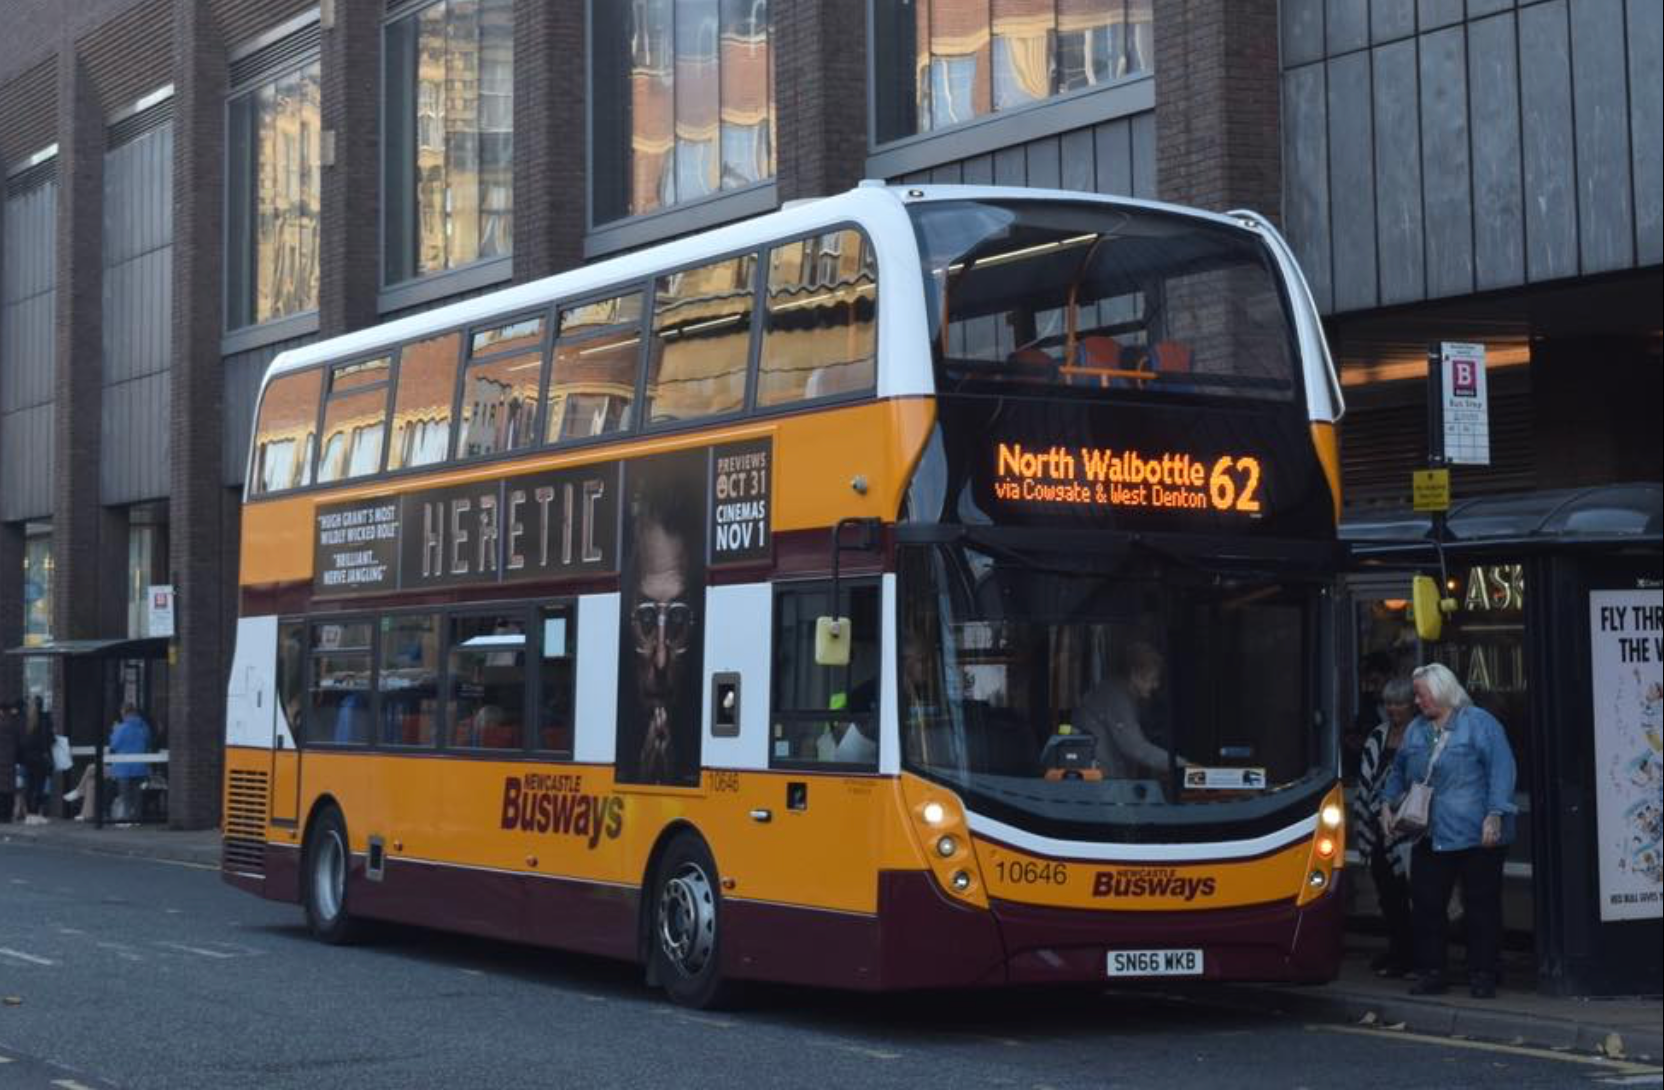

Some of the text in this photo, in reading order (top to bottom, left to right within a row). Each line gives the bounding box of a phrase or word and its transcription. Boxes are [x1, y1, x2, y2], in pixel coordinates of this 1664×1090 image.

[1456, 363, 1472, 386] B
[717, 452, 766, 474] PREVIEWS
[998, 443, 1206, 487] North Walbottle
[716, 470, 766, 499] OCT 31
[995, 478, 1207, 509] via Cowgate & West Denton
[1208, 455, 1261, 512] 62
[716, 500, 766, 523] CINEMAS
[421, 479, 605, 578] HERETIC
[716, 520, 765, 551] NOV 1
[1601, 605, 1627, 632] FLY
[1618, 636, 1650, 664] THE
[523, 773, 582, 793] NEWCASTLE
[500, 775, 625, 850] Busways
[996, 860, 1068, 886] 10646
[1092, 870, 1216, 902] Busways
[1114, 951, 1196, 973] SN66 WKB
